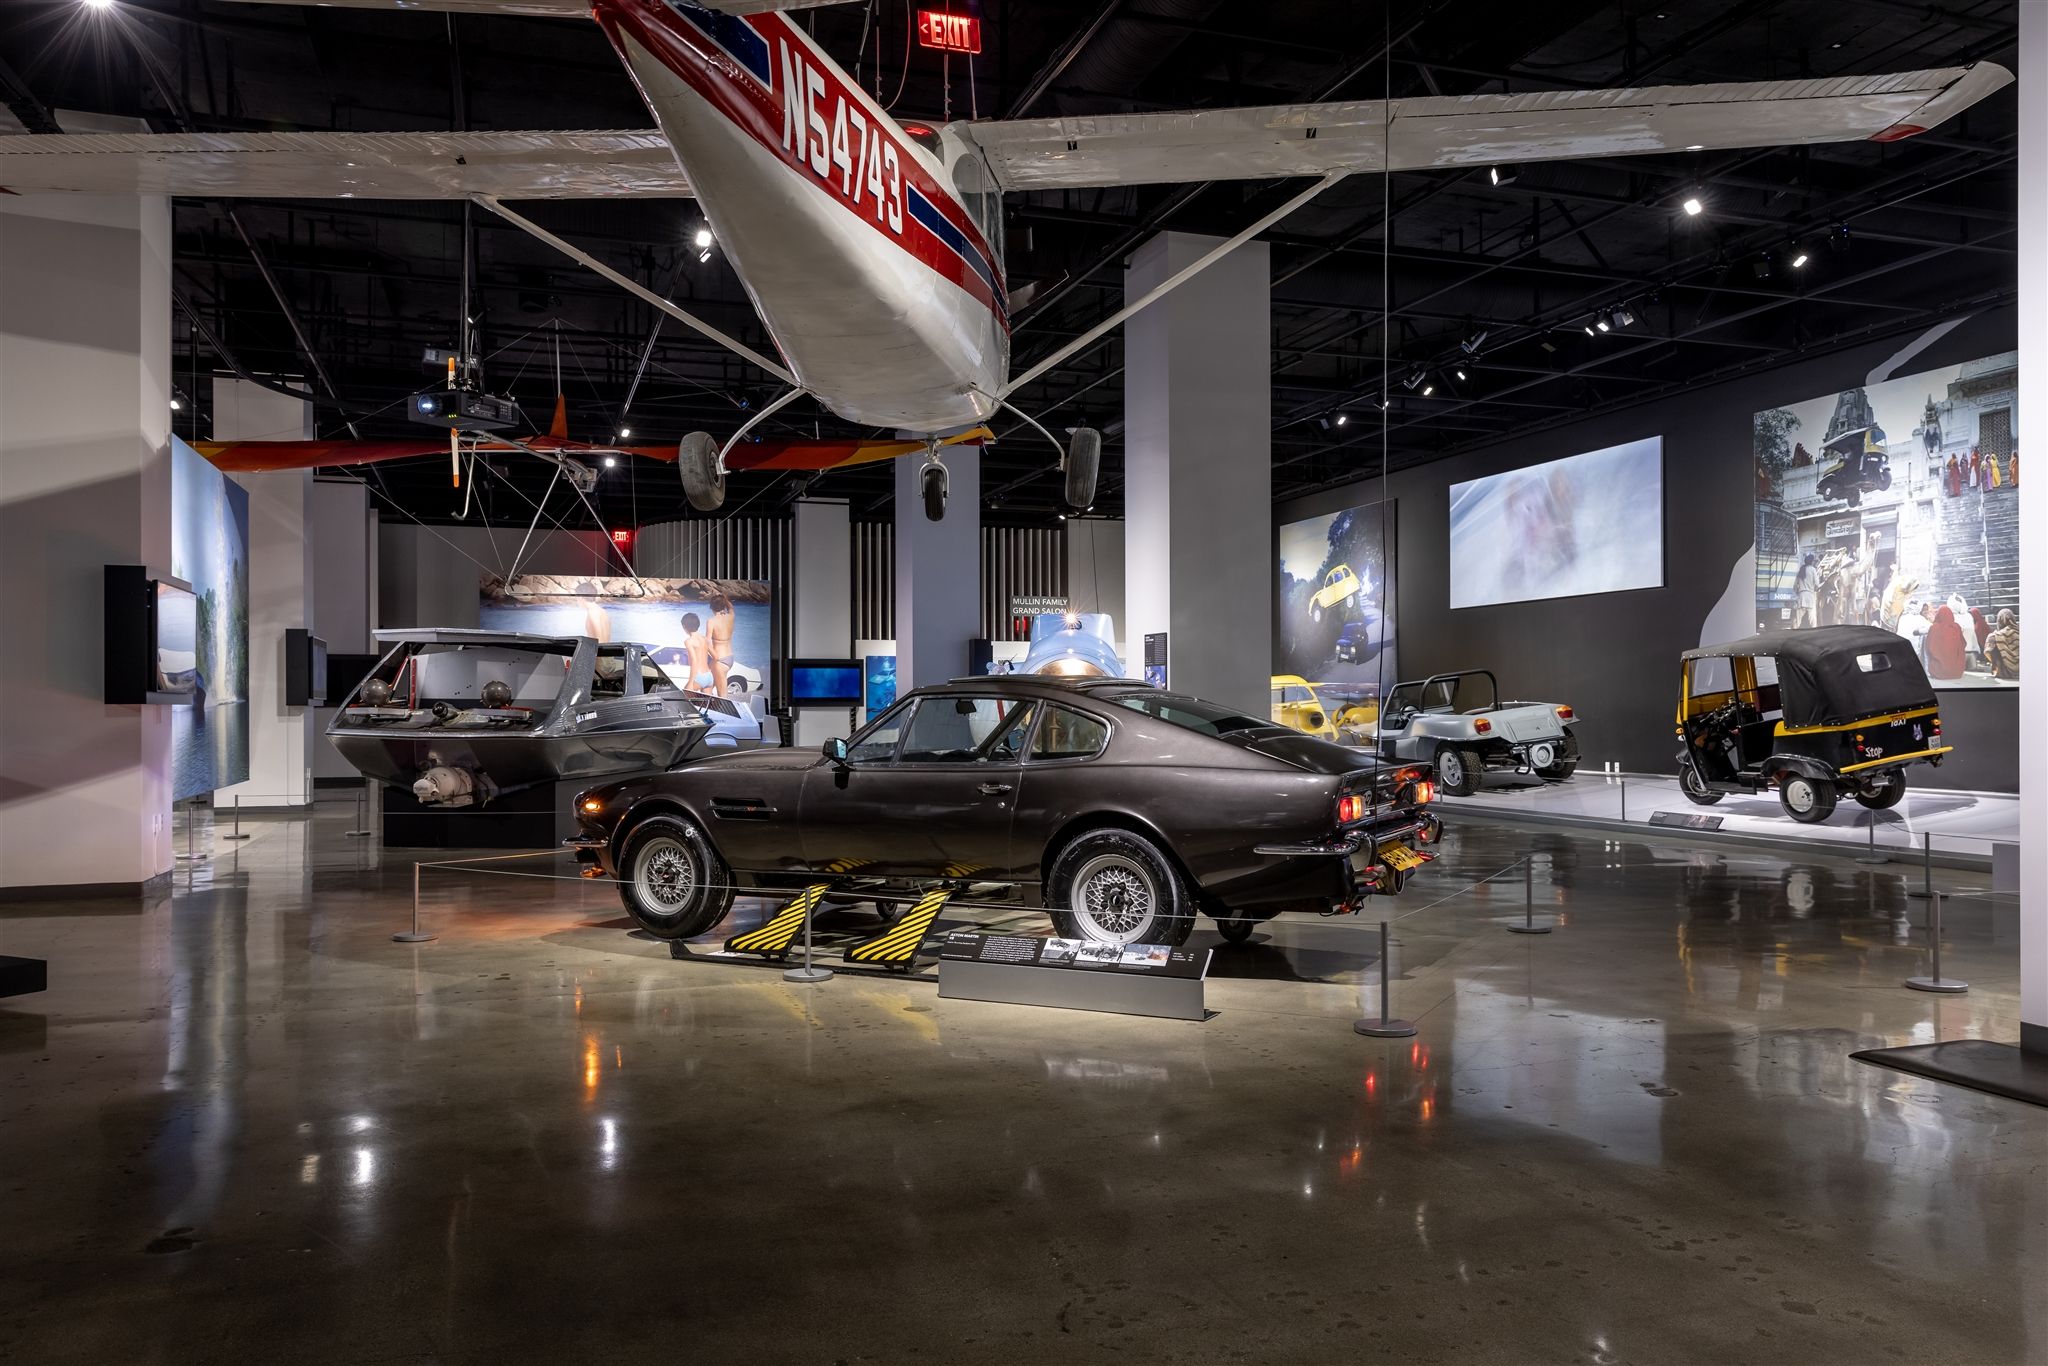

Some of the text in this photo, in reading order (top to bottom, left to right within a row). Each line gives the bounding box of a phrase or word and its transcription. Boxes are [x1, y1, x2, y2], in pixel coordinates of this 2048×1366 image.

[930, 13, 970, 47] EXIT
[780, 37, 903, 235] N54743
[1012, 607, 1040, 615] GRAND
